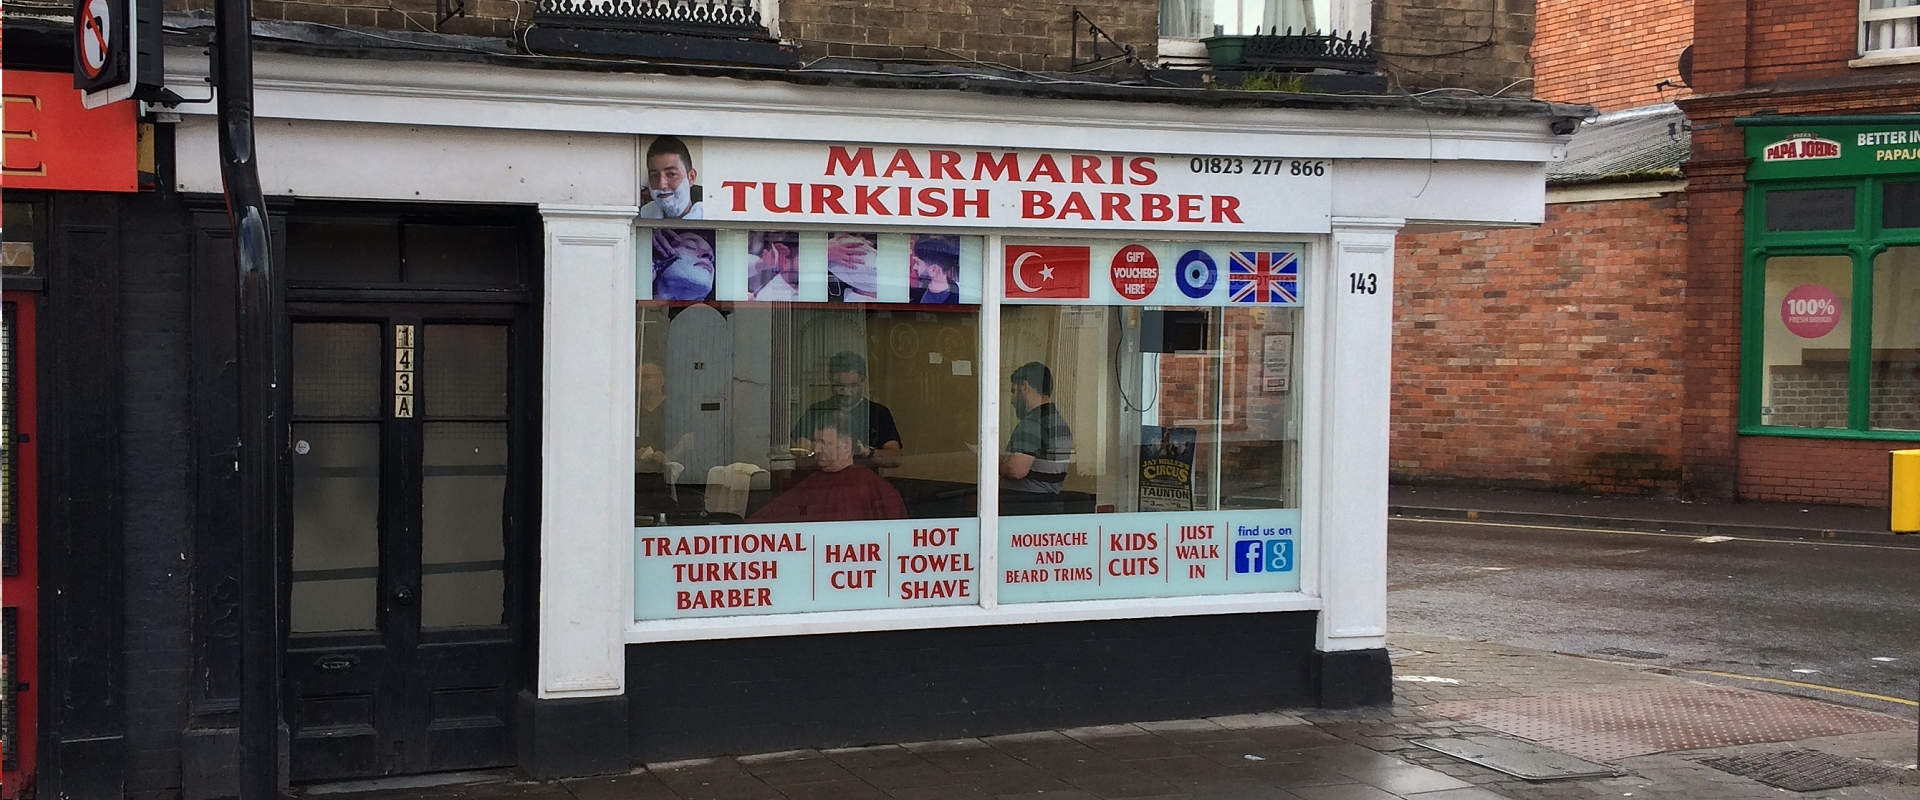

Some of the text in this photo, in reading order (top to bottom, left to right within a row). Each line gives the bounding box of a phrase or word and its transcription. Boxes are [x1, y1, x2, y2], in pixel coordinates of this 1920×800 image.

[1857, 131, 1907, 146] BETTER
[1767, 140, 1838, 160] PAPA JOHNS
[824, 145, 1158, 186] MARMARIS
[1189, 157, 1325, 177] 01823 277 866
[721, 180, 1244, 225] TURKISH BARBER
[1126, 251, 1145, 263] GIFT
[1113, 267, 1158, 279] VOUCHERS
[1124, 283, 1146, 295] HERE
[1349, 272, 1378, 296] 143
[1787, 299, 1835, 316] 100%
[1143, 465, 1189, 483] CIRCUS
[1142, 487, 1190, 500] TAUNTON
[913, 528, 960, 548] HOT
[1011, 532, 1088, 547] MOUSTACHE
[1180, 525, 1215, 543] JUST
[1237, 525, 1292, 536] find us on
[641, 532, 807, 557] TRADITIONAL
[1110, 532, 1158, 552] KIDS
[1175, 544, 1220, 560] WALK
[825, 542, 882, 563] HAIR
[1035, 551, 1065, 565] AND
[672, 561, 778, 583] TURKISH
[897, 553, 975, 574] TOWEL
[1108, 557, 1159, 577] CUTS
[1188, 564, 1206, 579] IN
[830, 569, 877, 590] CUT
[1005, 567, 1093, 584] BEARD TRIMS
[676, 588, 773, 611] BARBER
[900, 579, 971, 601] SHAVE
